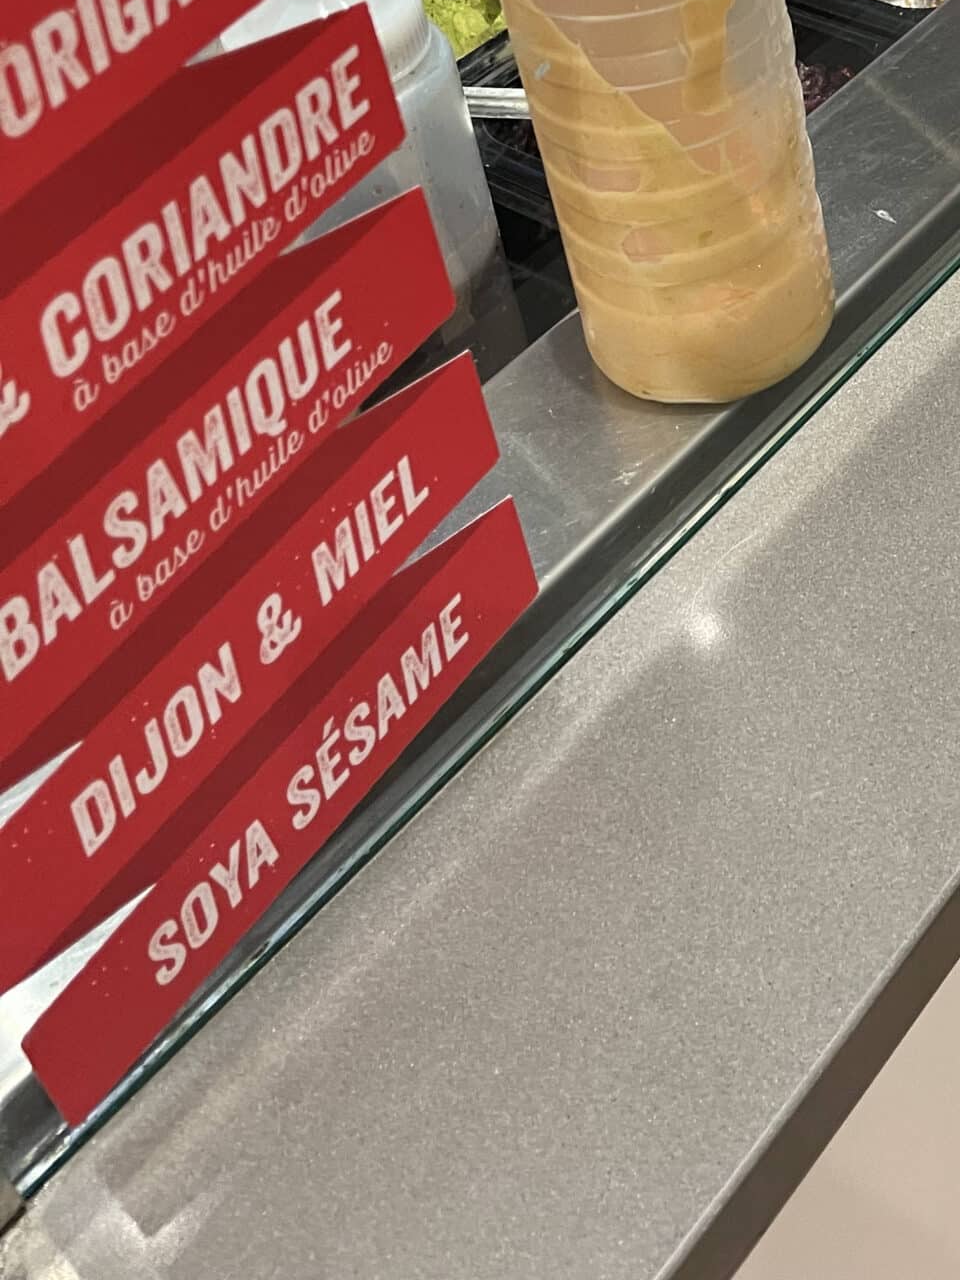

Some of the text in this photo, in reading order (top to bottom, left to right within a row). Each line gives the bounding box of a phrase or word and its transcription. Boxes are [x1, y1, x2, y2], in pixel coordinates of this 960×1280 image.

[40, 44, 372, 380] CORIANDRE
[102, 310, 176, 385] base
[180, 216, 281, 316] d'huile
[284, 129, 376, 222] d'olive
[0, 289, 352, 683] BALSAMIQUE
[135, 528, 205, 603] base
[209, 427, 304, 533] d'huile
[308, 339, 394, 435] d'olive
[69, 455, 431, 858] DIJON & MIEL
[147, 592, 471, 987] SOYA SÉSAME
